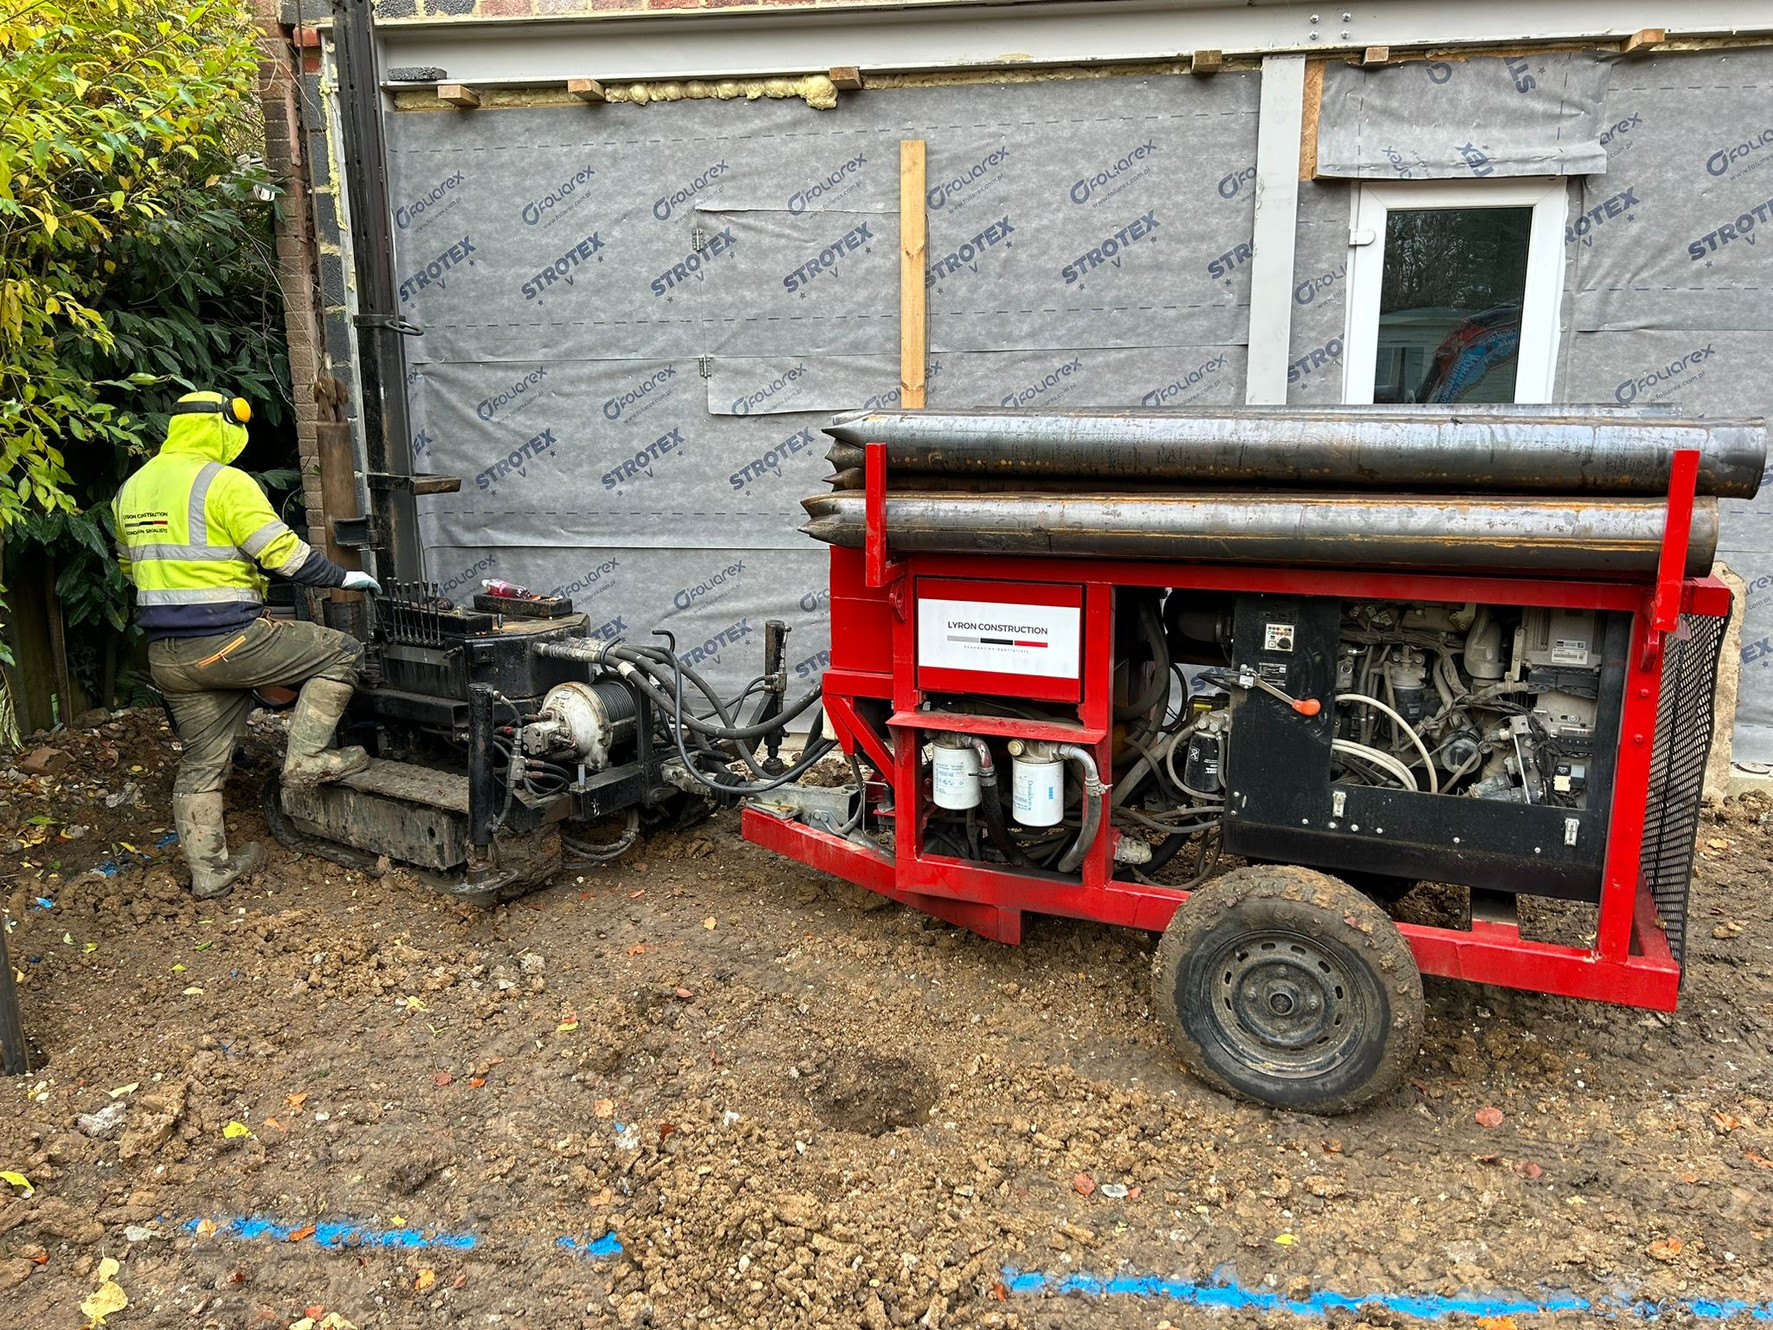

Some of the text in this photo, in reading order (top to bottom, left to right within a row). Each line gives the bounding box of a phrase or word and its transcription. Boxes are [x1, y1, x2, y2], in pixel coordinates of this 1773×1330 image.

[1600, 112, 1643, 145] arex
[1565, 186, 1640, 246] ROTEX
[1582, 235, 1593, 248] V
[1688, 198, 1773, 261] STROT
[1745, 232, 1756, 246] V
[399, 236, 477, 302] STROTEX
[521, 231, 605, 300] STROTEX
[650, 227, 738, 297] STROTEX
[783, 221, 874, 293] STROTEX
[829, 266, 839, 279] V
[925, 215, 1015, 290] STROTEX
[969, 261, 979, 274] V
[1061, 210, 1161, 284] STROTEX
[1111, 256, 1122, 269] V
[437, 278, 446, 290] V
[565, 274, 574, 286] V
[1287, 332, 1344, 384] STRO
[475, 427, 557, 490] STROTEX
[518, 466, 527, 478] V
[601, 427, 685, 491] STROTEX
[645, 466, 654, 479] V
[729, 427, 815, 491] STROTEX
[773, 466, 783, 479] V
[679, 618, 753, 670] TROTEX
[947, 621, 1048, 635] LYRON CONSTRUCTION
